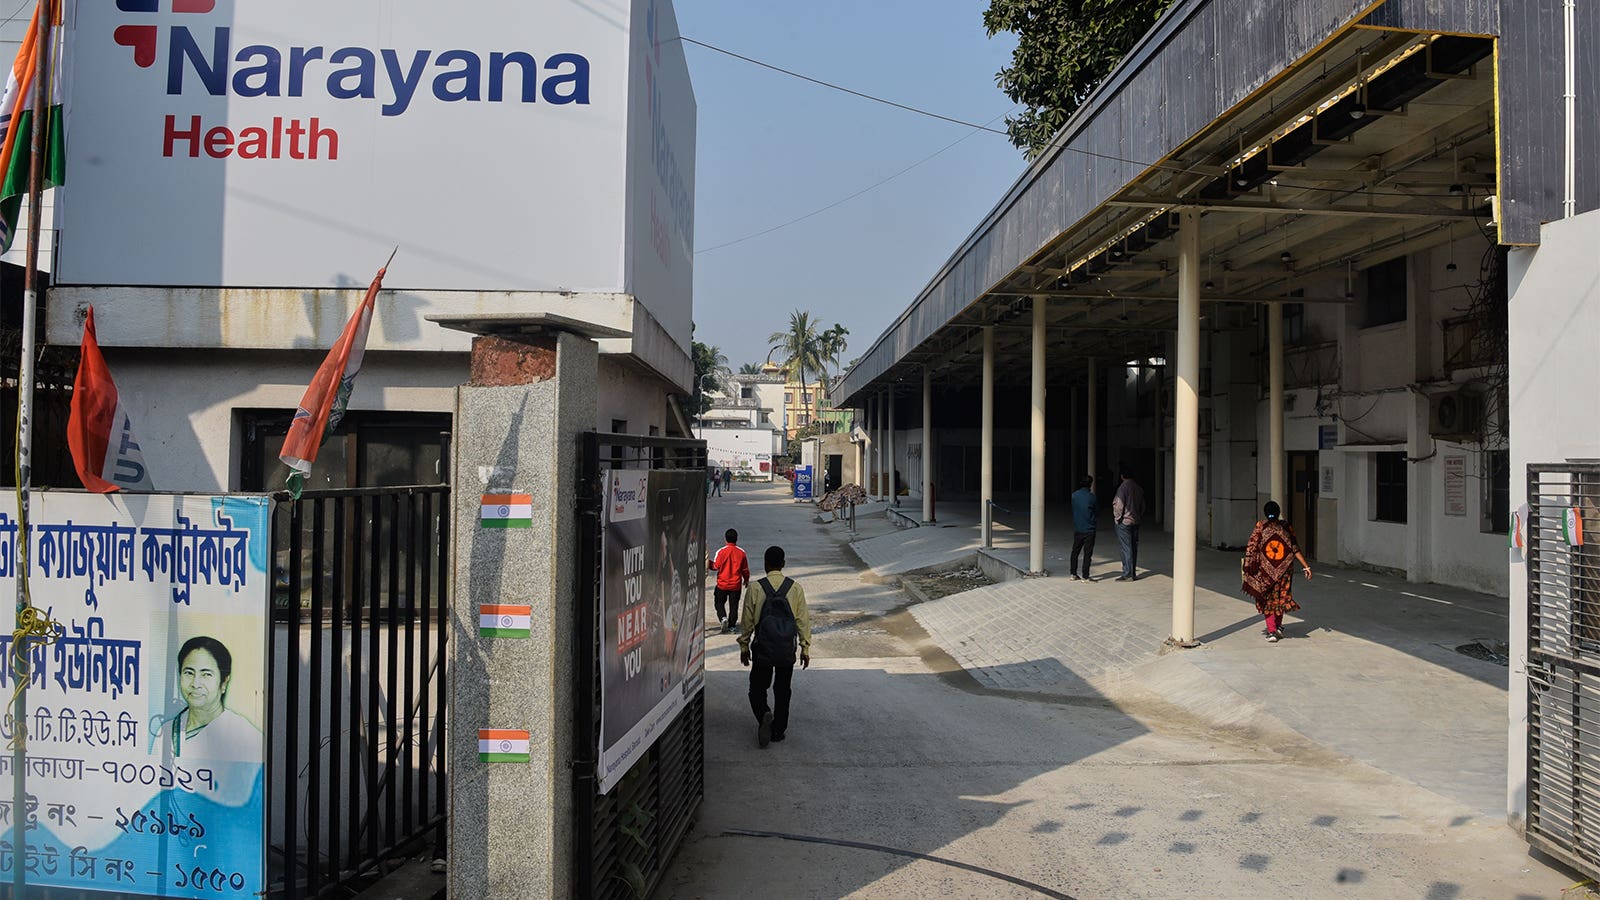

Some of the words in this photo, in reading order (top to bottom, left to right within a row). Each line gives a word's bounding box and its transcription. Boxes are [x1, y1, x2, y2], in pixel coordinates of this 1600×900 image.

[167, 26, 590, 117] Narayana
[163, 115, 338, 160] Health
[37, 520, 136, 610] ক্যাজুয়াল
[623, 545, 645, 576] WITH
[625, 574, 642, 605] YOU
[617, 607, 647, 644] NEAR
[53, 617, 141, 700] ইউনিয়ন
[624, 647, 642, 681] YOU
[0, 706, 138, 748] এ.টি.টি.ইউ.সি
[0, 755, 214, 791] াকাতা-৭০০১২৭
[47, 803, 77, 828] নং
[69, 846, 97, 880] সি
[105, 858, 136, 883] নং
